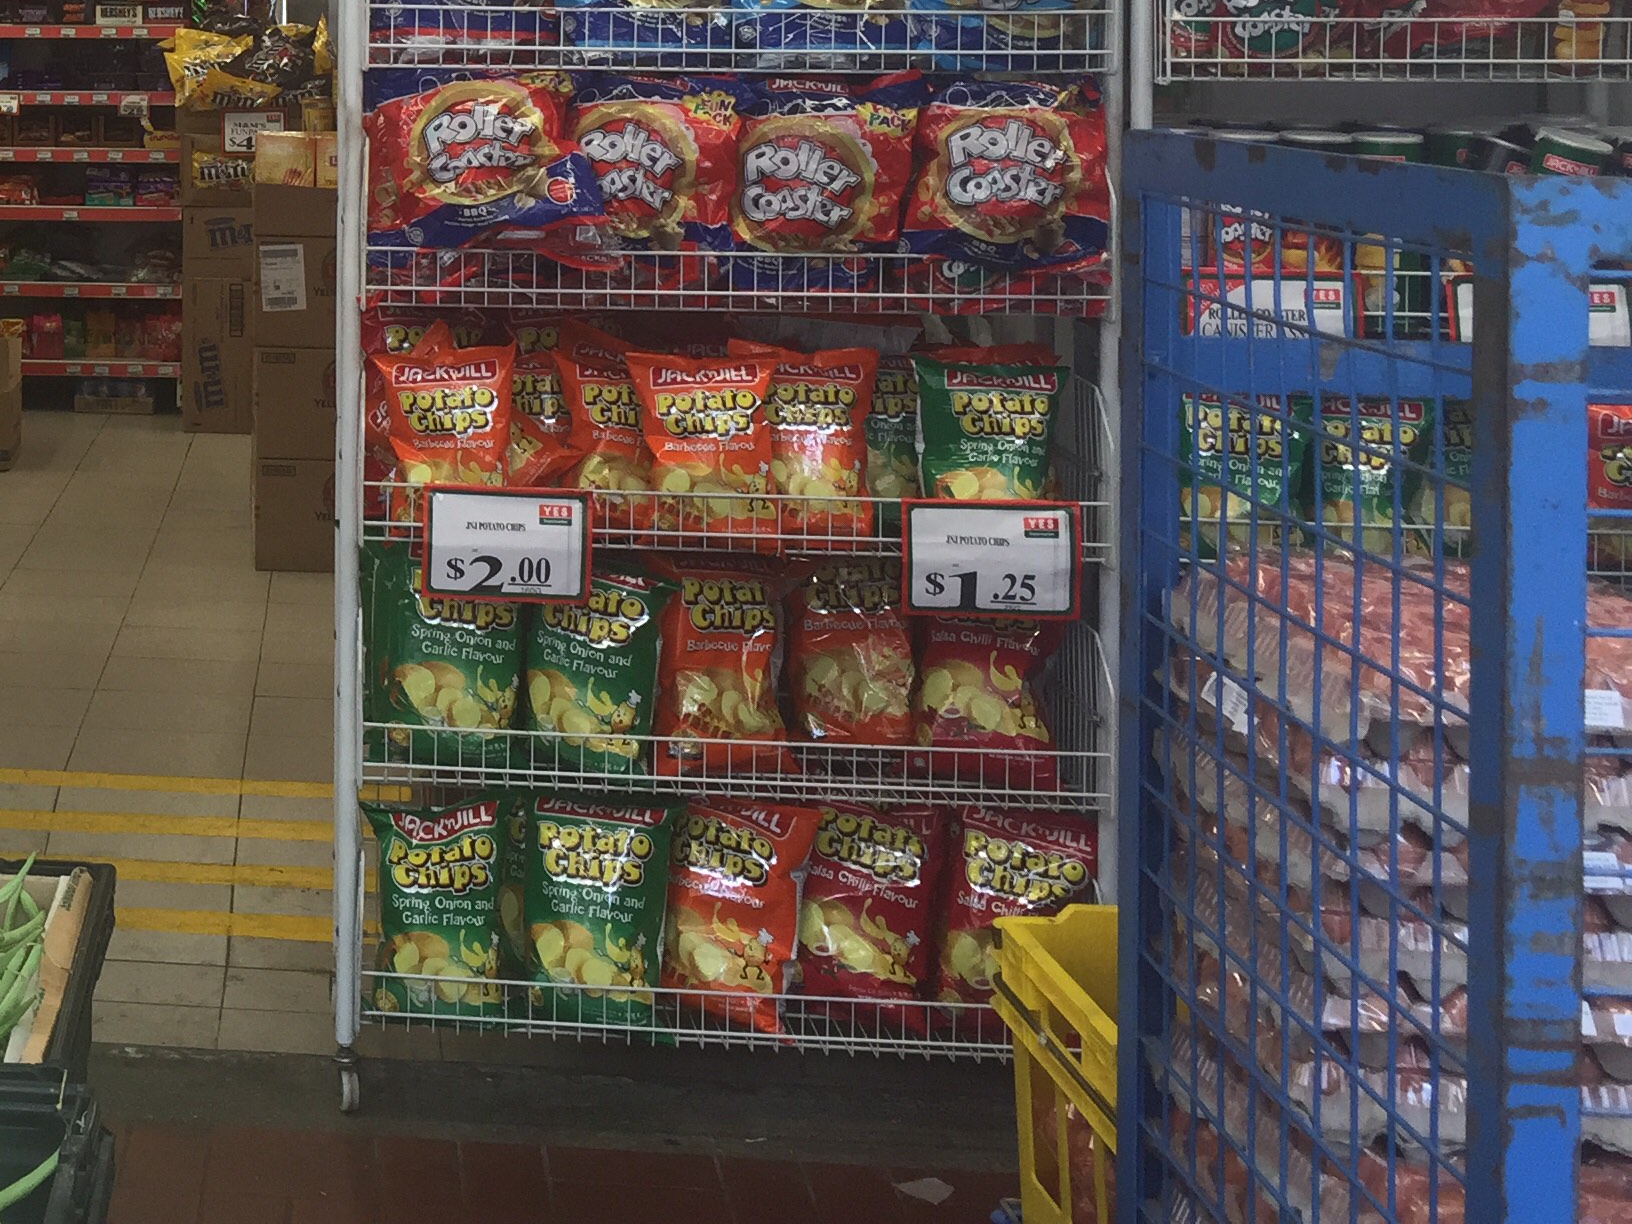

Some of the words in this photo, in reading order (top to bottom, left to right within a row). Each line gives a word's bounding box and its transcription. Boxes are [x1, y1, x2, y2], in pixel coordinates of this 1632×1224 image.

[100, 5, 137, 18] HERSHEY'S
[423, 103, 537, 156] Roller
[868, 112, 911, 132] PACK
[580, 122, 683, 177] Roller
[948, 119, 1064, 171] Roller
[744, 141, 863, 195] Roller
[946, 165, 1064, 207] Coaster
[462, 207, 487, 217] BBQ
[741, 184, 852, 228] Coaster
[399, 386, 497, 414] Potato
[655, 388, 758, 416] Potato
[951, 392, 1050, 416] Potato
[409, 409, 496, 437] Chips
[664, 409, 751, 439] Chips
[961, 414, 1047, 438] Chips
[960, 439, 994, 454] Spring
[997, 440, 1029, 454] Onion
[968, 452, 999, 464] Garlic
[1001, 454, 1039, 467] Flavour
[543, 506, 568, 516] YES
[1028, 518, 1055, 529] YES
[479, 522, 505, 531] POTATO
[506, 523, 526, 532] CHIPS
[960, 536, 987, 546] POTATO
[988, 537, 1010, 547] CHIPS
[446, 555, 551, 592] $2.00
[925, 572, 1037, 609] $1.25
[411, 623, 451, 643] Spring
[455, 630, 492, 648] Onion
[496, 638, 516, 651] and
[543, 602, 632, 645] Chips
[960, 630, 992, 646] Chilli
[422, 641, 458, 658] Garlic
[462, 647, 504, 664] Flavour
[537, 630, 568, 654] Spring
[570, 643, 605, 666] Onion
[609, 653, 633, 667] and
[543, 649, 571, 667] Garlic
[572, 660, 618, 679] Flavour
[538, 822, 654, 860] Potato
[819, 806, 925, 859] Potato
[388, 834, 496, 868] Potato
[817, 829, 919, 881] Chips
[965, 829, 1086, 886] Potato
[392, 863, 491, 893] Chips
[543, 850, 643, 888] Chips
[966, 859, 1070, 906] Chips
[392, 894, 430, 913] Spring
[435, 896, 472, 910] Onion
[475, 897, 494, 910] and
[542, 881, 578, 902] Spring
[582, 887, 620, 905] Onion
[624, 896, 646, 911] and
[838, 871, 869, 894] Chilli
[873, 885, 919, 909] Flavour
[402, 911, 438, 926] Garlic
[442, 912, 485, 926] Flavour
[550, 900, 585, 915] Garlic
[588, 905, 634, 923] Flavour
